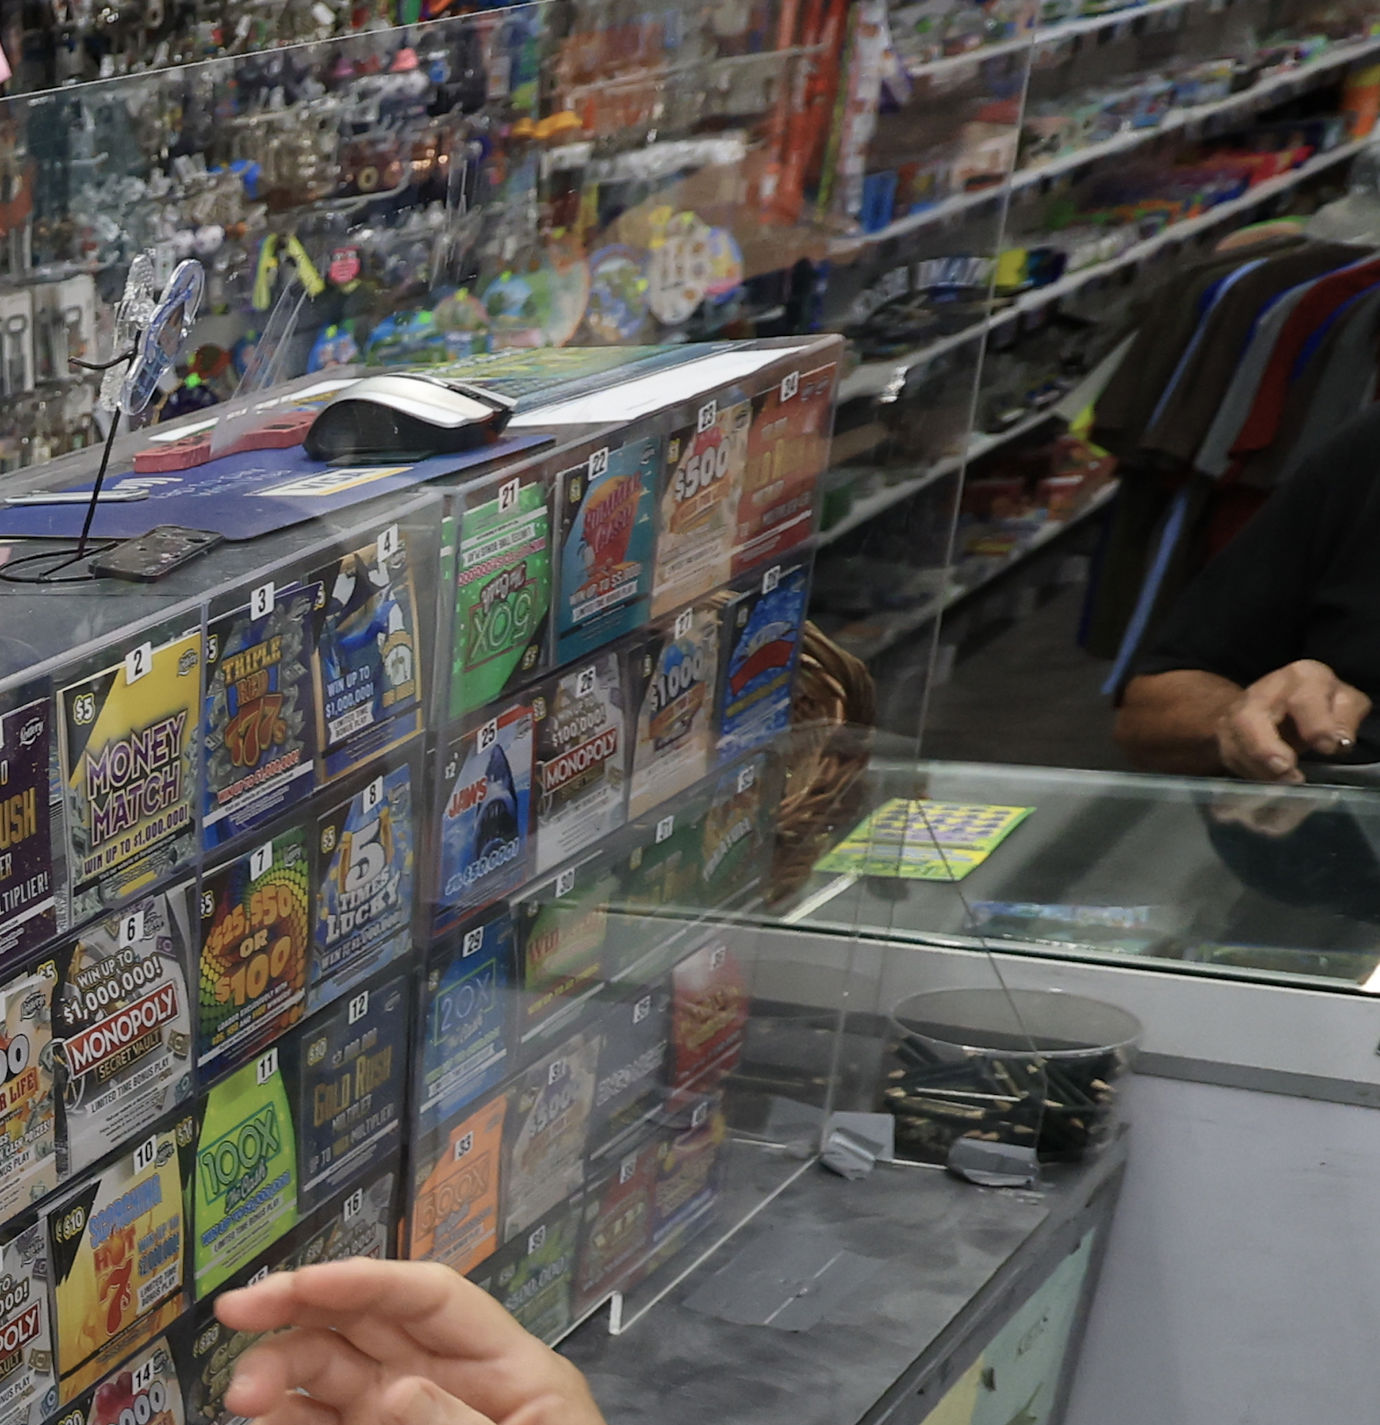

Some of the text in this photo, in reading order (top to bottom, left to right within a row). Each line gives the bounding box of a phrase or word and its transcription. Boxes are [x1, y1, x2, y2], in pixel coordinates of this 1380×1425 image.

[258, 588, 268, 614] 3
[222, 636, 282, 684] TRIPLE
[85, 709, 188, 800] MONEY
[546, 730, 617, 789] MONOPOLY
[90, 760, 184, 847] MATCH
[327, 873, 400, 944] LUCKY
[63, 956, 162, 1025] $1,000,000!
[77, 950, 133, 989] WIN UP TO
[71, 990, 176, 1070] MONOPOLY
[99, 1051, 131, 1078] SECRET
[202, 1109, 278, 1192] 100X
